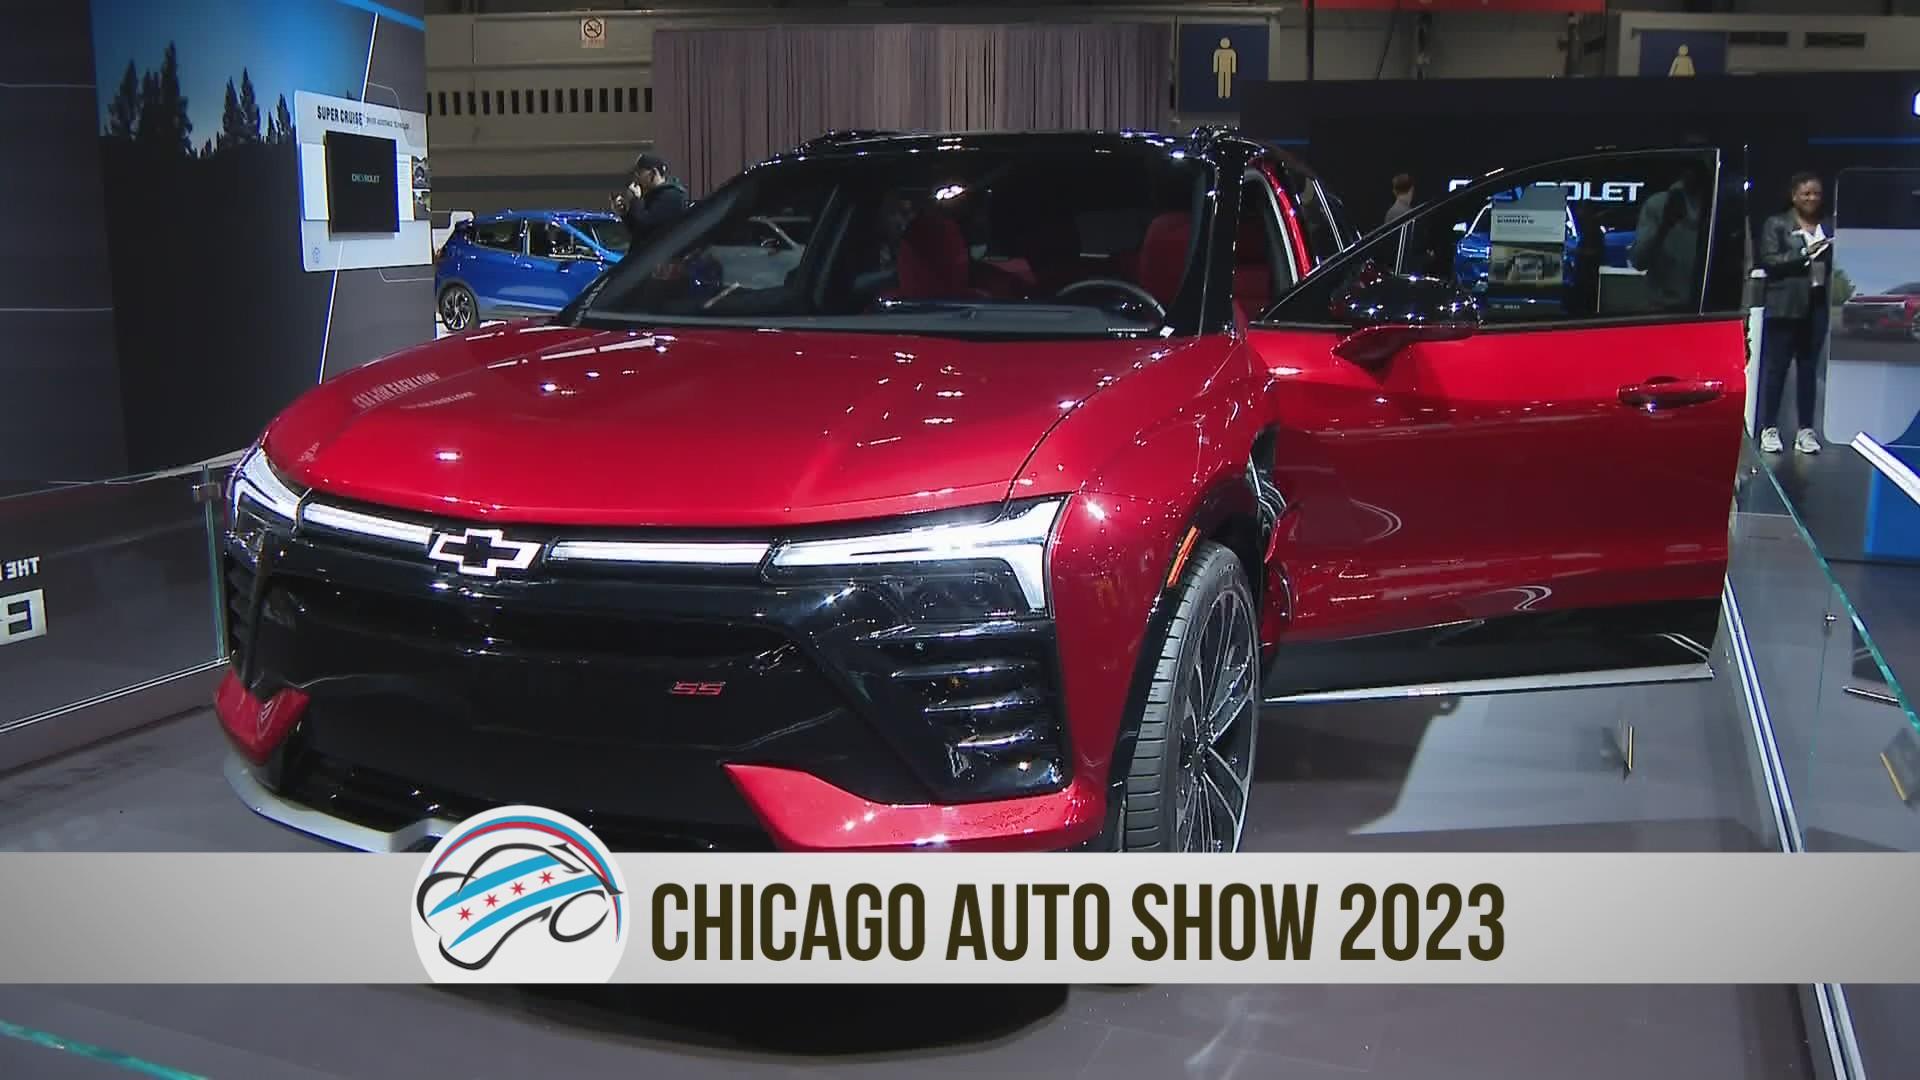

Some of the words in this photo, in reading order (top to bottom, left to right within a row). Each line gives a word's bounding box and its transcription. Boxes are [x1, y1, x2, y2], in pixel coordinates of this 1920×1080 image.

[317, 105, 339, 122] SUPER
[340, 109, 363, 126] CRUISE
[672, 681, 726, 696] SS
